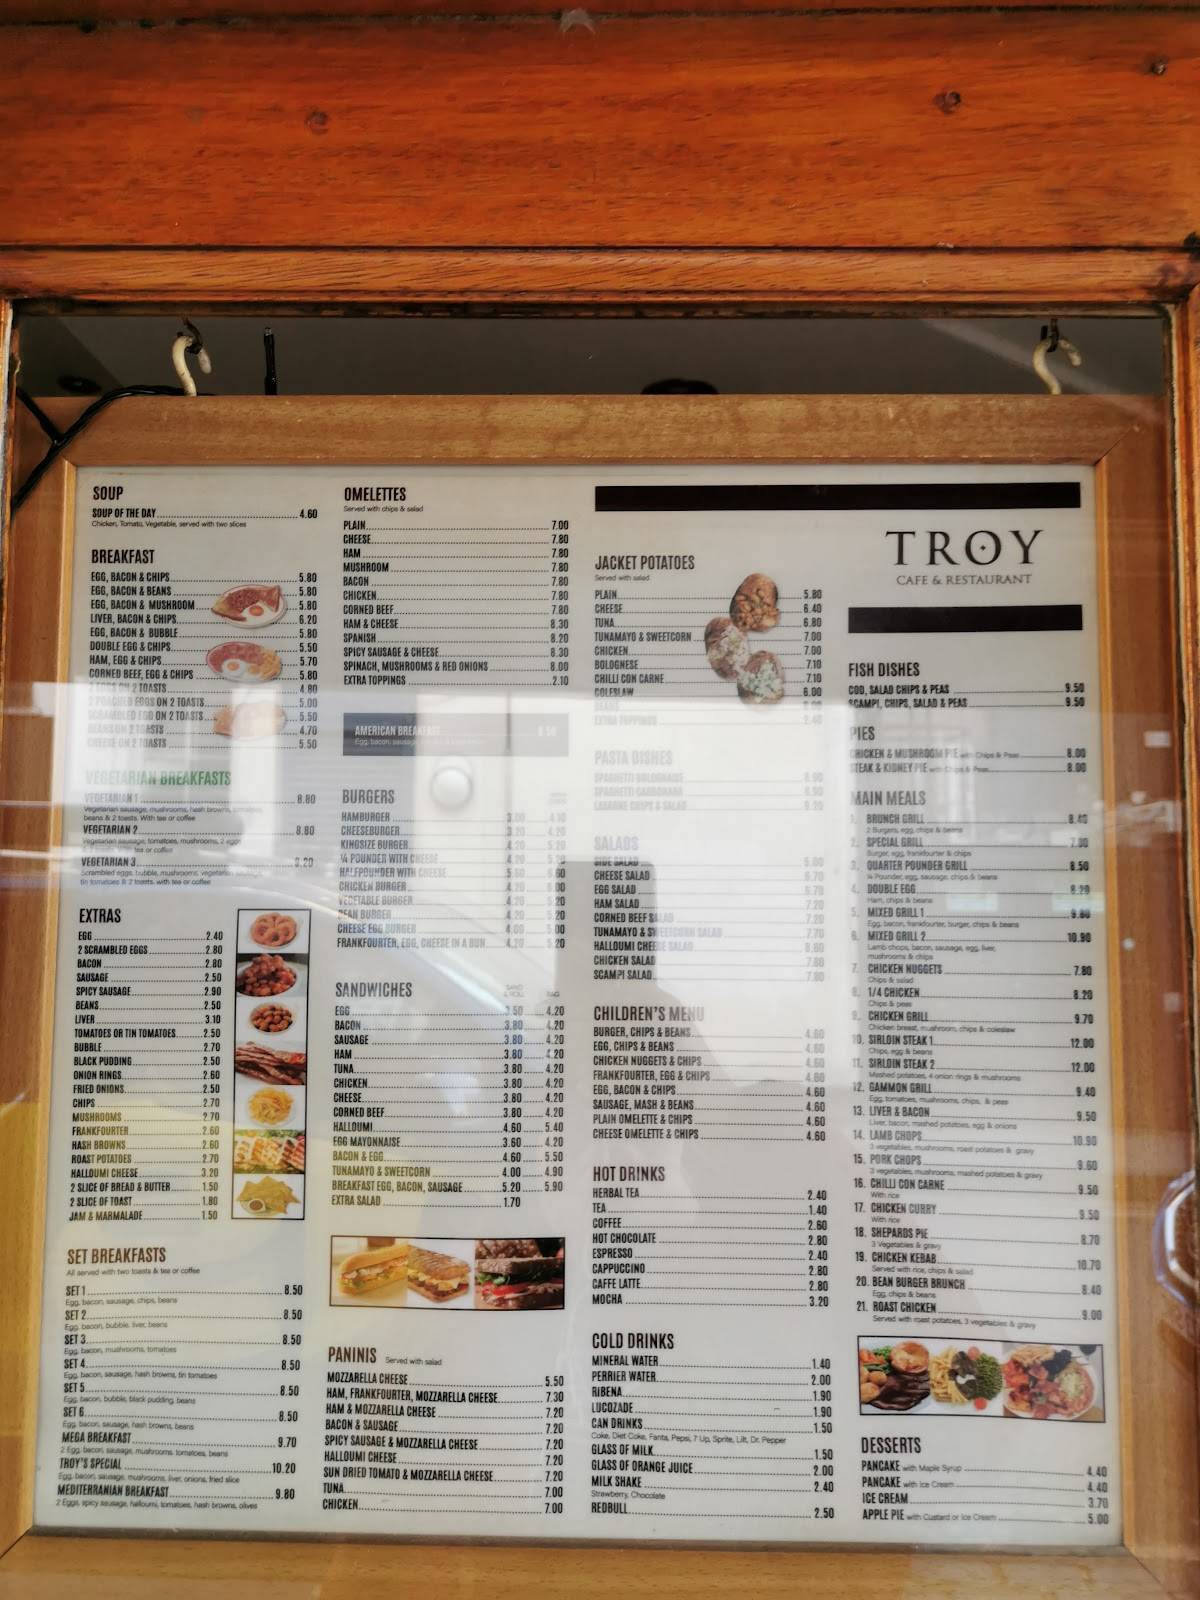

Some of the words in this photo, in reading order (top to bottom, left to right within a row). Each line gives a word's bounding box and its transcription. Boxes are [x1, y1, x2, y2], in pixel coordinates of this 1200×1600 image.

[93, 486, 123, 500] SOUP
[344, 487, 406, 501] OMELETTES
[92, 509, 112, 518] SOUP
[114, 509, 124, 518] OF
[126, 509, 140, 518] THE
[142, 509, 155, 518] DAY
[300, 509, 317, 518] 4.60
[344, 521, 366, 530] PLAIN
[552, 521, 569, 530] 7.00
[886, 530, 1044, 566] TROY
[92, 550, 155, 563] BREAKFAST
[595, 556, 637, 570] JACKET
[641, 556, 695, 570] POTATOES
[896, 575, 928, 586] CAFE
[933, 576, 941, 585] &
[946, 574, 1032, 585] RESTAURANT
[91, 600, 109, 611] EGG,
[111, 600, 136, 610] BACON
[139, 600, 144, 610] &
[149, 600, 195, 610] MUSHROOM
[300, 601, 317, 610] 5.80
[595, 604, 623, 614] CHEESE
[804, 604, 822, 613] 6.40
[595, 632, 636, 641] TUNAMAYO
[639, 632, 644, 641] &
[646, 632, 691, 641] SWEETCORN
[804, 632, 822, 641] 7.00
[344, 662, 380, 673] SPINACH,
[382, 662, 432, 671] MUSHROOMS
[435, 662, 440, 671] &
[443, 662, 456, 671] RED
[459, 662, 488, 671] ONIONS
[551, 662, 569, 672] 8.00
[849, 663, 874, 677] FISH
[879, 662, 920, 676] DISHES
[870, 685, 894, 694] SALAD
[896, 685, 920, 694] CHIPS
[922, 685, 928, 694] &
[930, 685, 949, 694] PEAS
[1065, 683, 1084, 693] 9.50
[343, 790, 394, 804] BURGERS
[341, 812, 390, 822] HAMBURGER
[83, 825, 131, 834] VEGETARIAN
[133, 825, 138, 834] 2
[296, 826, 314, 835] 8.80
[867, 861, 903, 871] QUARTER
[905, 861, 943, 871] POUNDER
[945, 861, 968, 871] GRILL
[1070, 861, 1089, 871] 8.50
[594, 871, 624, 880] CHEESE
[626, 871, 650, 880] SALAD
[79, 908, 121, 923] EXTRAS
[78, 946, 83, 955] 2
[84, 945, 127, 955] SCRAMBLED
[129, 945, 148, 955] EGGS
[205, 946, 222, 955] 2.80
[336, 982, 412, 997] SANDWICHES
[868, 987, 882, 997] 1/4
[884, 988, 920, 997] CHICKEN
[1073, 990, 1093, 1000] 8.20
[75, 1029, 112, 1038] TOMATOES
[114, 1029, 123, 1038] OR
[125, 1029, 136, 1038] TIN
[138, 1029, 176, 1038] TOMATOES
[203, 1029, 221, 1038] 2.50
[333, 1122, 373, 1132] HALLOUMI
[503, 1123, 522, 1133] 4.60
[545, 1122, 563, 1132] 5.40
[593, 1115, 616, 1124] PLAIN
[619, 1115, 659, 1125] OMELETTE
[660, 1115, 666, 1124] &
[668, 1115, 692, 1125] CHIPS
[806, 1117, 825, 1127] 4.60
[593, 1167, 616, 1181] HOT
[619, 1167, 665, 1181] DRINKS
[67, 1249, 88, 1264] SET
[91, 1248, 166, 1264] BREAKFASTS
[181, 1267, 200, 1275] coffee
[592, 1264, 645, 1274] CAPPUCCINO
[809, 1266, 828, 1276] 2.80
[66, 1286, 79, 1296] SET
[82, 1286, 86, 1296] 1
[284, 1285, 303, 1296] 8.50
[856, 1276, 869, 1288] 20.
[872, 1277, 893, 1288] BEAN
[896, 1277, 928, 1289] BURGER
[931, 1278, 965, 1290] BRUNCH
[1082, 1285, 1101, 1295] 8.40
[856, 1301, 868, 1312] 21.
[873, 1302, 898, 1312] ROAST
[900, 1302, 936, 1313] CHICKEN
[592, 1333, 623, 1349] COLD
[628, 1333, 674, 1349] DRINKS
[328, 1347, 377, 1363] PANINIS
[386, 1357, 408, 1365] Served
[327, 1372, 377, 1383] MOZZARELLA
[379, 1373, 408, 1384] CHEESE
[545, 1376, 564, 1387] 5.50
[861, 1437, 921, 1454] DESSERTS
[90, 1458, 121, 1469] SPECIAL
[272, 1463, 296, 1474] 10.20
[592, 1460, 616, 1470] GLASS
[619, 1460, 630, 1471] OF
[632, 1461, 666, 1472] ORANGE
[668, 1462, 693, 1473] JUICE
[814, 1465, 833, 1476] 2.00
[862, 1460, 900, 1472] PANCAKE
[903, 1464, 917, 1472] with
[919, 1464, 940, 1473] Maple
[942, 1464, 961, 1473] Syrup
[323, 1467, 340, 1478] SUN
[342, 1468, 367, 1478] DRIED
[369, 1468, 400, 1479] TOMATO
[403, 1470, 408, 1480] &
[410, 1470, 461, 1481] MOZZARELLA
[464, 1471, 493, 1481] CHEESE
[545, 1471, 563, 1481] 7.20
[58, 1485, 123, 1496] MEDITERRANIAN
[125, 1486, 169, 1498] BREAKFAST
[276, 1489, 295, 1500] 9.80
[631, 1491, 665, 1500] Chocolate
[863, 1493, 876, 1504] ICE
[878, 1493, 908, 1504] CREAM
[592, 1502, 627, 1513] REDBULL
[815, 1508, 834, 1518] 2.50
